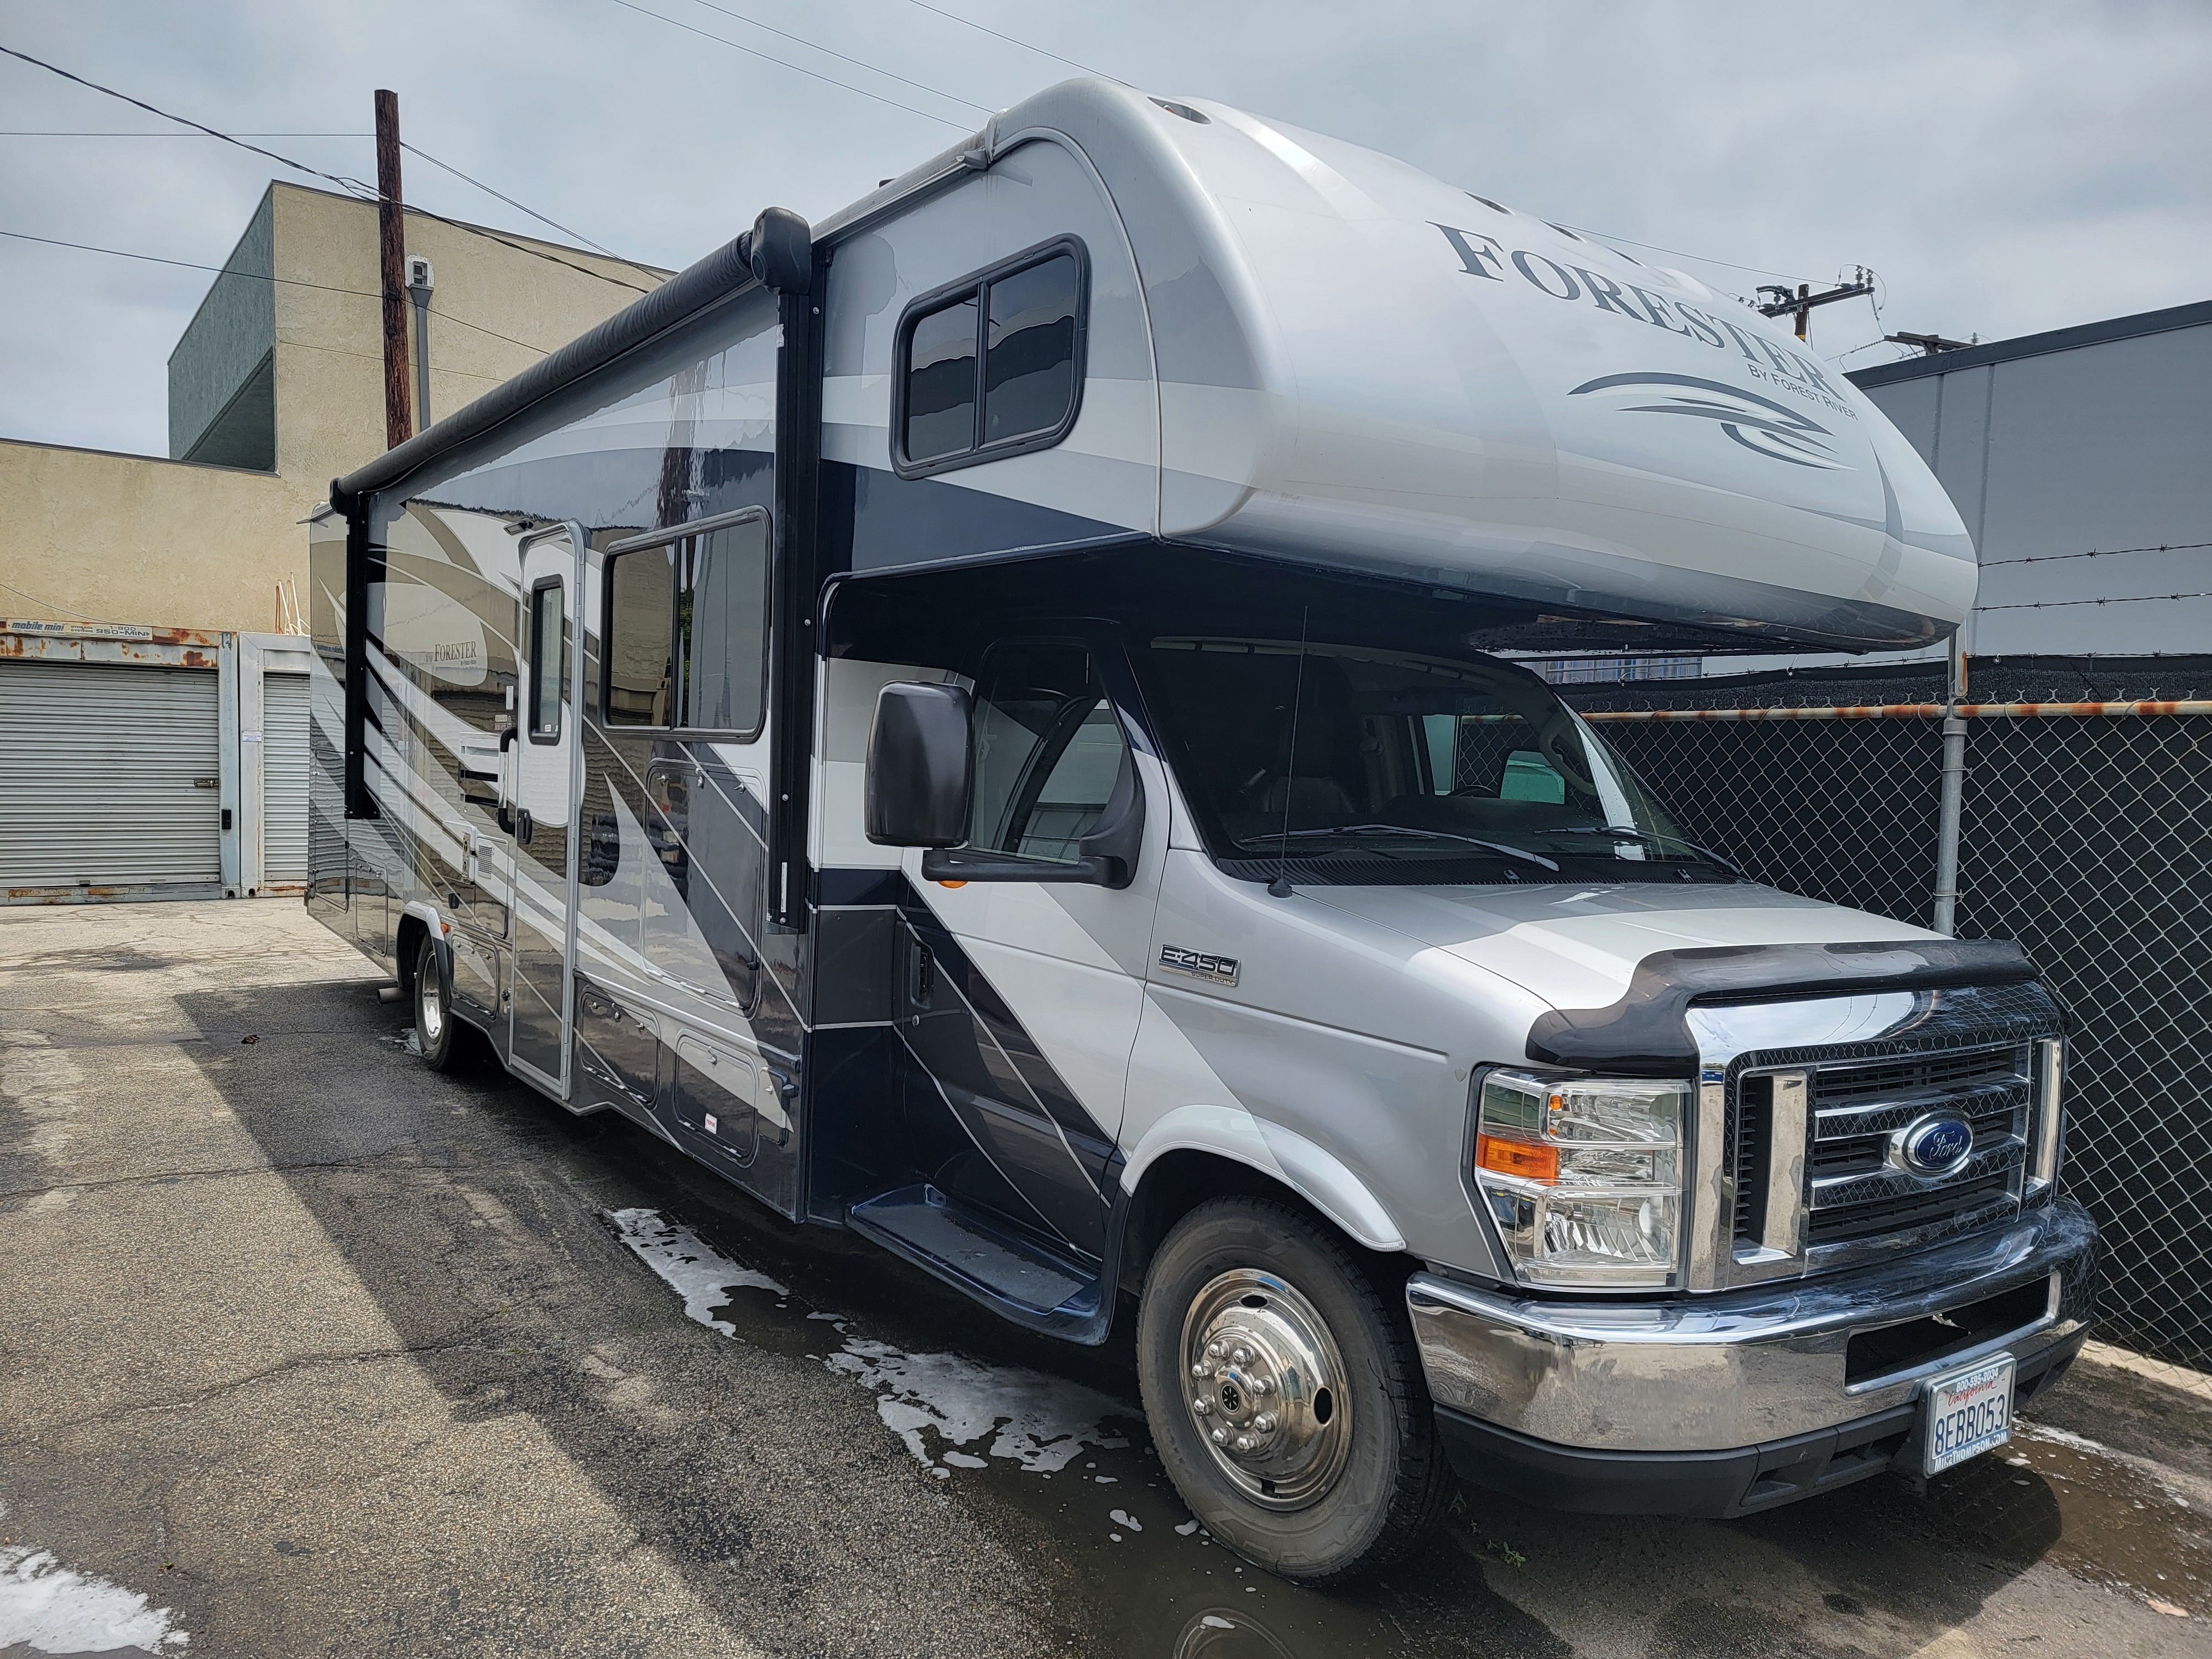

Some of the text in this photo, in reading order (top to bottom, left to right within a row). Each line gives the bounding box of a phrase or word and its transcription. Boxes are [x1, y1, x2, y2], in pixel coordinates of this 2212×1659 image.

[1425, 221, 1847, 403] FORESTER
[1747, 363, 1859, 421] BY FOREST RIVER
[12, 621, 43, 630] mobile
[434, 641, 477, 661] FORESTER
[1191, 971, 1213, 980] SUPER
[1929, 1130, 1963, 1160] Ford
[1948, 1380, 1998, 1407] California
[1955, 1367, 1999, 1393] 800-595-2034
[1935, 1394, 2006, 1455] 8EBB053
